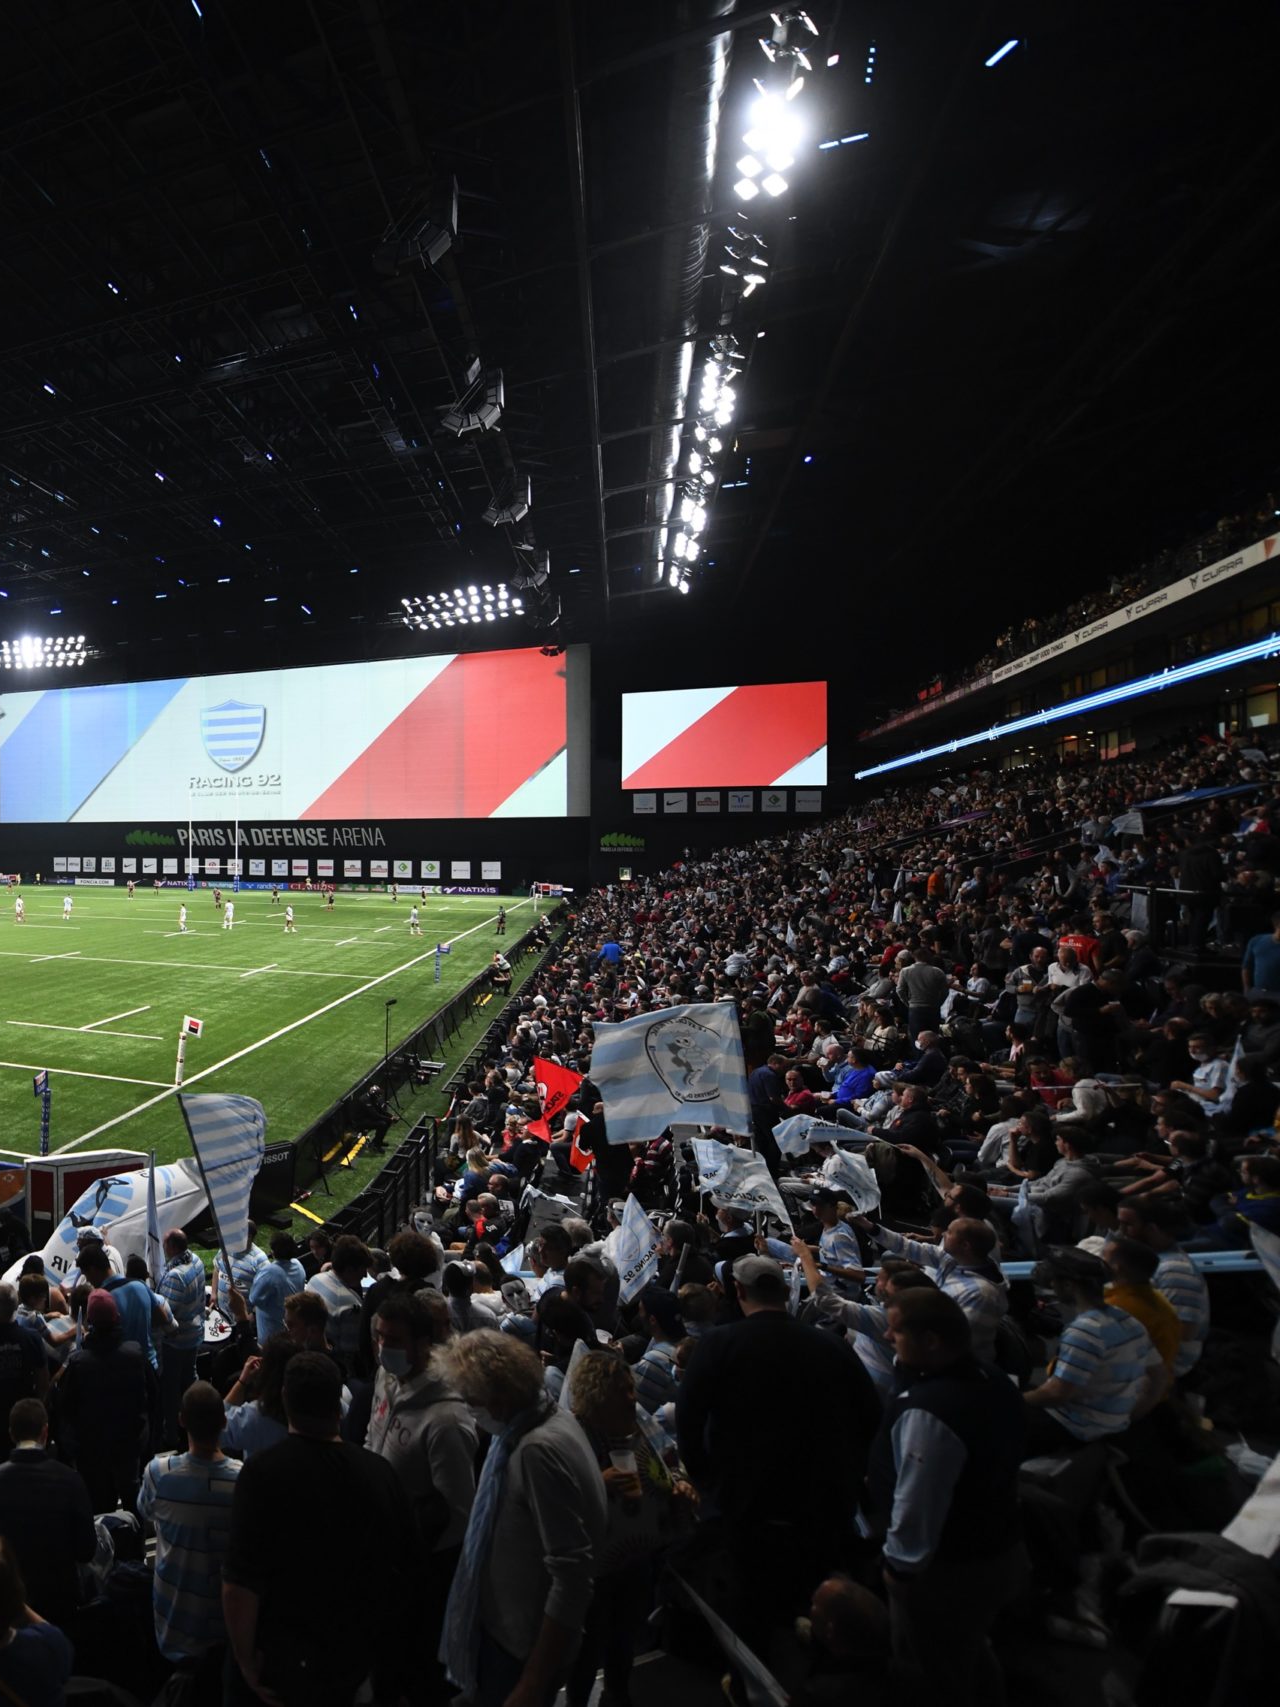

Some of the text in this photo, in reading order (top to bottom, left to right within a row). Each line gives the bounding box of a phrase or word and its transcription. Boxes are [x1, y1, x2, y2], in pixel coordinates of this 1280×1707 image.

[1202, 557, 1244, 583] CUPRA
[1135, 593, 1168, 614] CUPRA
[1082, 621, 1108, 639] CUPRA
[189, 774, 282, 789] RACING 92
[176, 827, 386, 847] PARIS LA DEFENSE ARENA
[458, 886, 496, 894] NATIXIS
